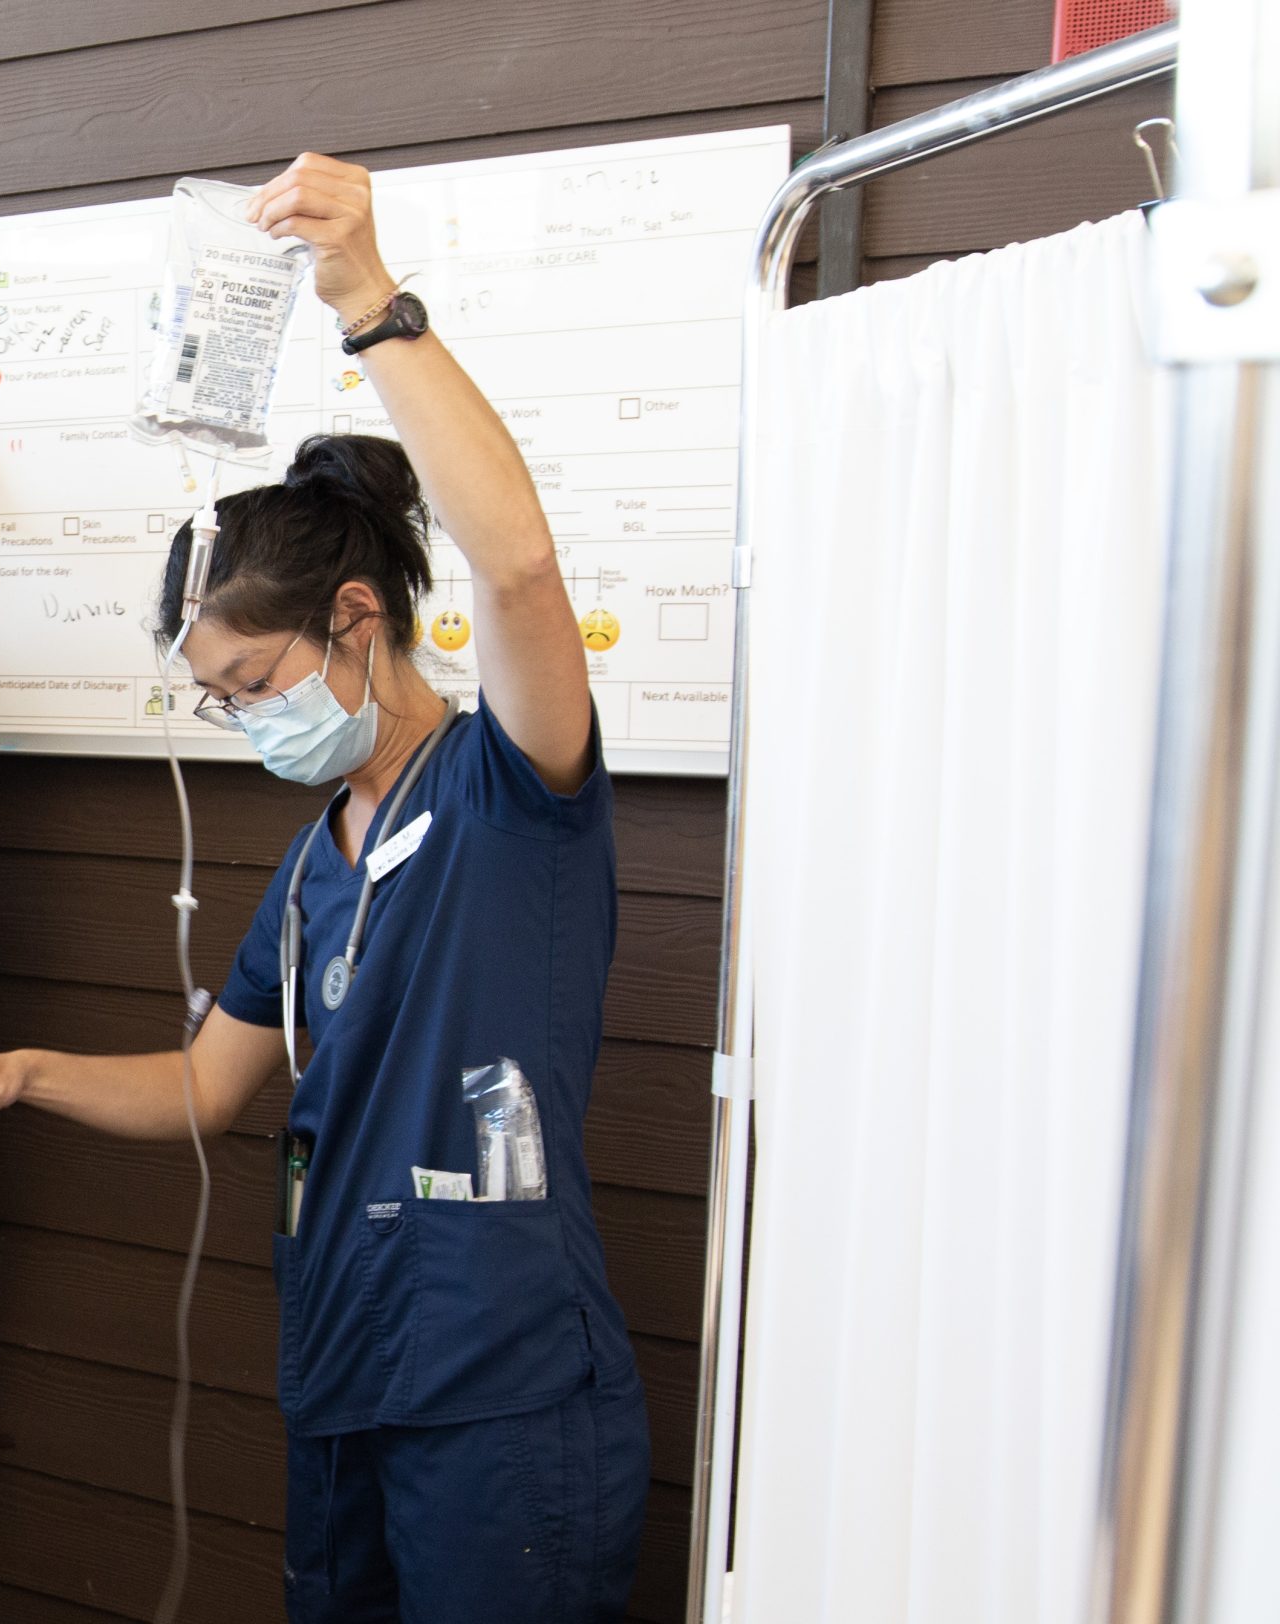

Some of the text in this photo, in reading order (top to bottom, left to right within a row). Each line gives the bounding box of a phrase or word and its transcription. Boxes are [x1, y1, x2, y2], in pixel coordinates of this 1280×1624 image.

[621, 216, 636, 226] Fri
[670, 210, 693, 222] Sun
[545, 223, 572, 234] Wed
[643, 220, 662, 232] Sat
[579, 226, 613, 238] Thurs
[206, 249, 220, 260] 20
[242, 254, 294, 273] POTASSIUM
[548, 252, 563, 265] OF
[566, 250, 597, 263] CARE
[13, 275, 40, 285] Room
[201, 279, 214, 289] 20
[220, 281, 280, 299] POTASSIUM
[224, 293, 273, 311] CHLORIDE
[12, 306, 34, 316] Your
[5, 373, 25, 382] Your
[26, 370, 58, 380] Patient
[61, 368, 81, 378] Care
[644, 400, 680, 412] Other
[511, 408, 542, 418] Work
[355, 416, 393, 427] Proced
[60, 430, 128, 442] Family Contact
[615, 499, 648, 510] Pulse
[0, 522, 17, 532] Fall
[82, 520, 102, 530] Skin
[623, 522, 646, 532] BGL
[0, 537, 53, 546] Precautions
[82, 535, 136, 545] Precautions
[21, 566, 36, 576] for
[37, 566, 52, 576] the
[646, 584, 730, 597] How Much?
[48, 680, 70, 690] Date
[72, 680, 81, 690] of
[642, 690, 728, 703] Next Available
